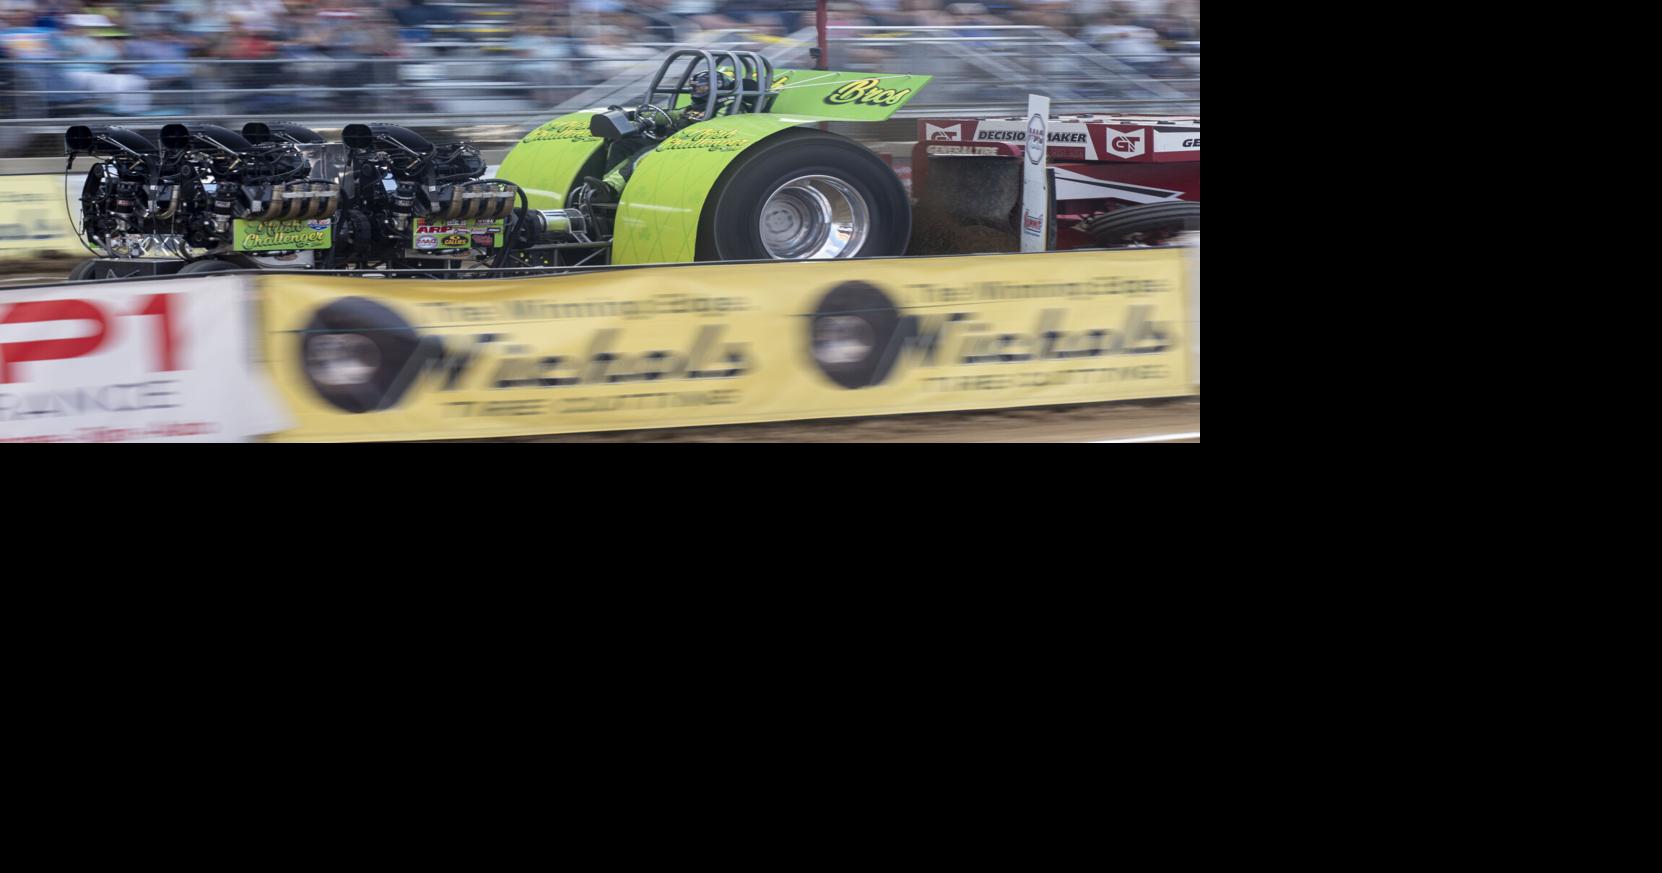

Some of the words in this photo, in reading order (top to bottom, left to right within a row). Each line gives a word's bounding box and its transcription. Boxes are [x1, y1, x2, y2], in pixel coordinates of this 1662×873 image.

[822, 77, 911, 107] Bros
[978, 130, 1026, 142] DECISIO
[1111, 136, 1141, 153] GT
[927, 146, 973, 156] GENERAL
[974, 146, 999, 155] TIRE
[243, 231, 326, 250] Challenger
